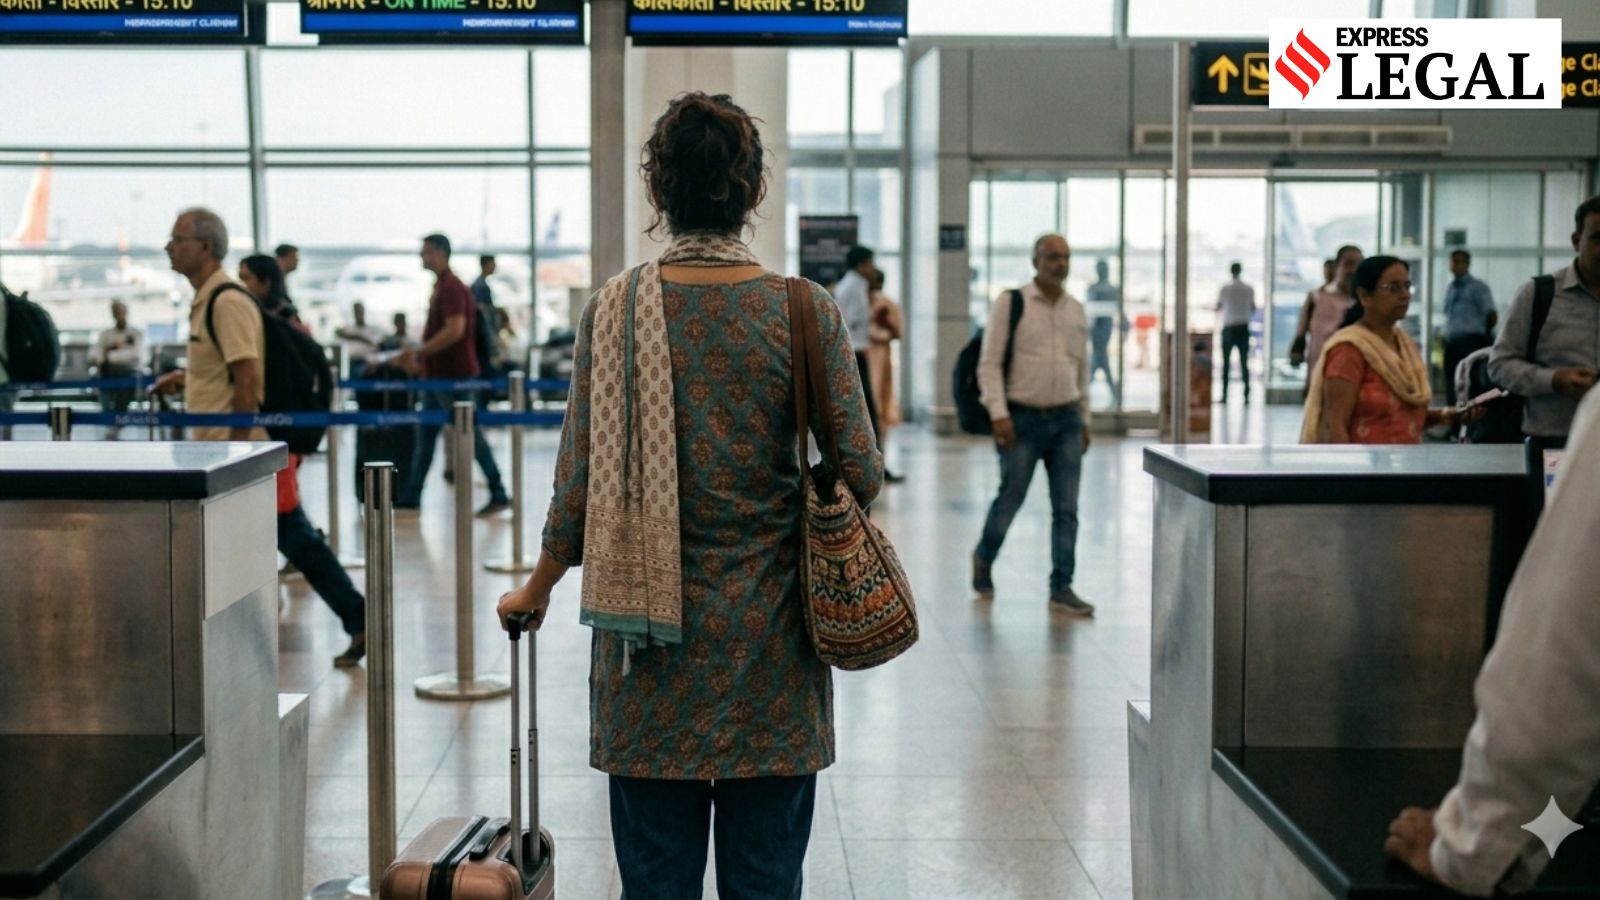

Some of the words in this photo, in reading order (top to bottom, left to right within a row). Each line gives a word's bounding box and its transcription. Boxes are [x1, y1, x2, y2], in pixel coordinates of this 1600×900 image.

[814, 0, 865, 11] 15:10
[1581, 53, 1600, 71] Cl
[1581, 79, 1600, 97] Cl
